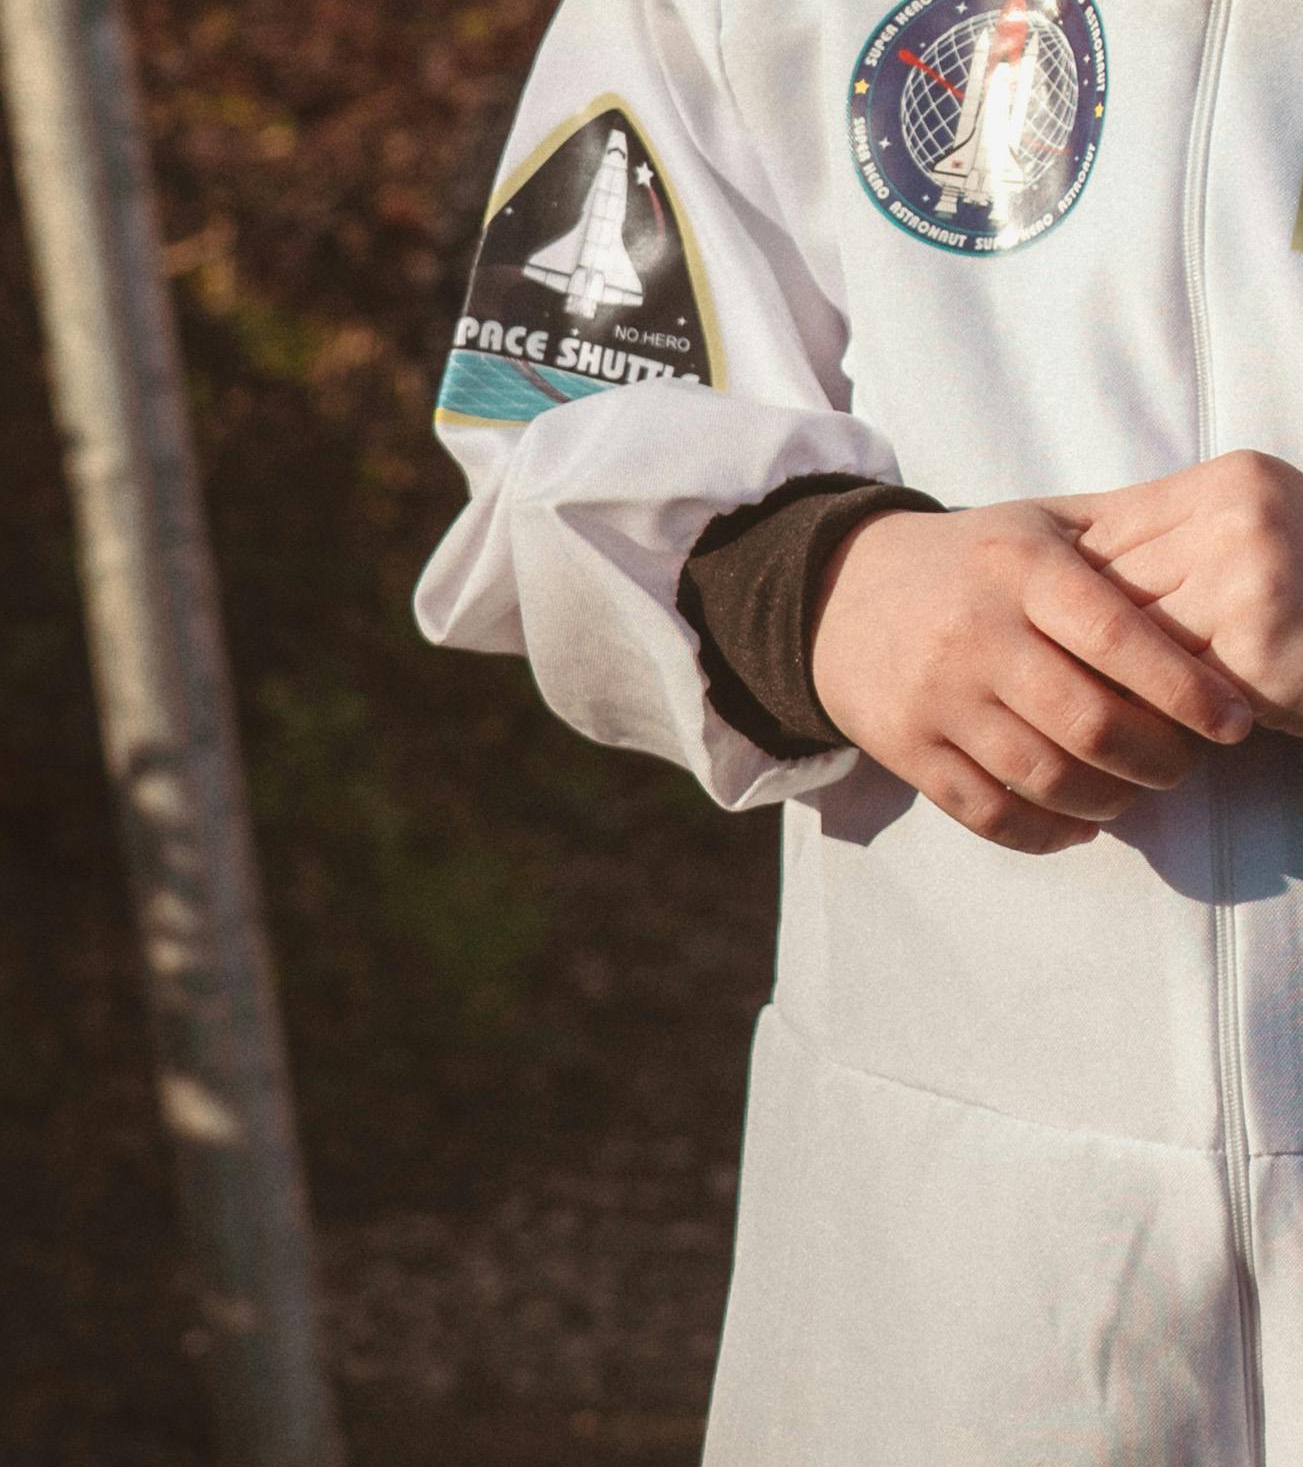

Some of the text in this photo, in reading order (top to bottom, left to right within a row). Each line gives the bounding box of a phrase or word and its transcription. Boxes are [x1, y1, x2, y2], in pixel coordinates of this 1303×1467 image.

[864, 23, 899, 68] SUPER
[1084, 5, 1106, 92] ASTRONAUT
[863, 161, 890, 200] HERO
[888, 200, 968, 248] ASTRONAUT
[1057, 142, 1096, 214] ASTRONAUT
[454, 316, 549, 361] PACE
